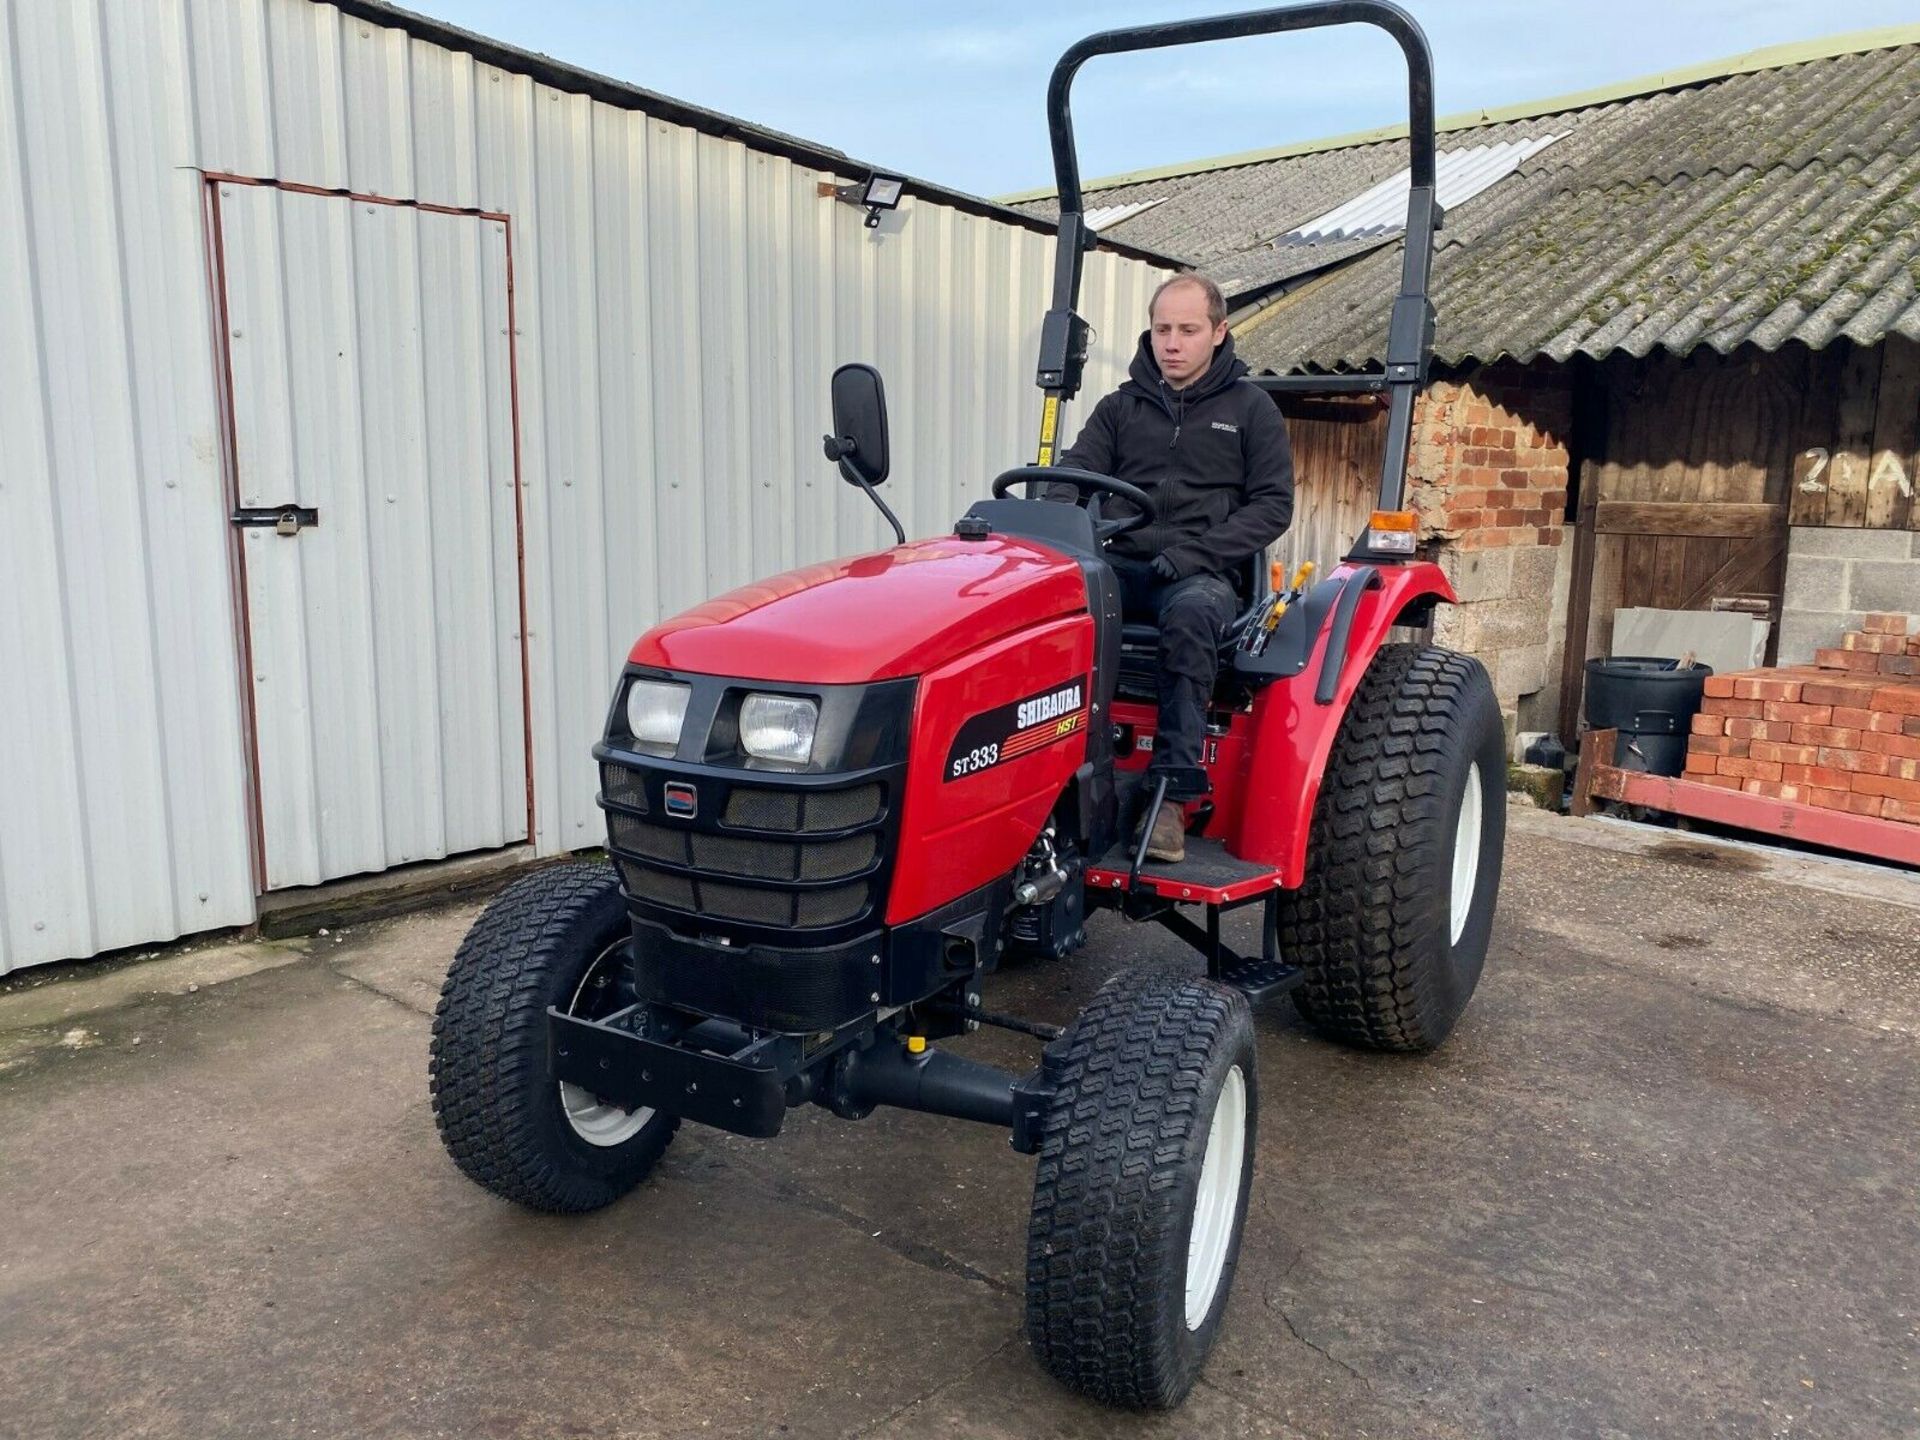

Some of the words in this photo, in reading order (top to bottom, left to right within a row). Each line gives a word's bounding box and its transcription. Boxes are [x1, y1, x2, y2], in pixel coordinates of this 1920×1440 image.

[1017, 685, 1081, 729] SHIBAURA
[1056, 716, 1078, 735] HST
[953, 743, 998, 776] ST333
